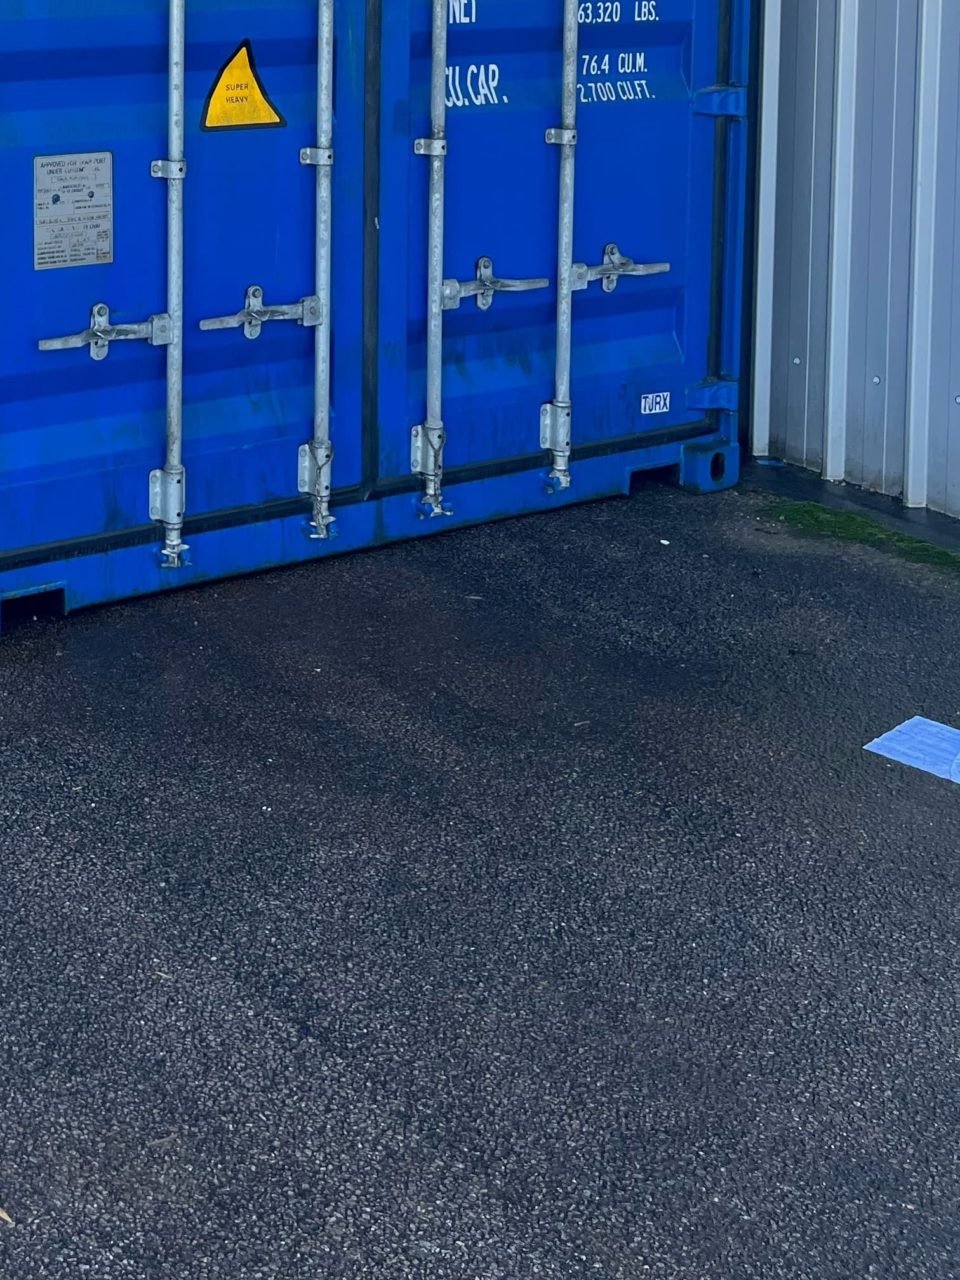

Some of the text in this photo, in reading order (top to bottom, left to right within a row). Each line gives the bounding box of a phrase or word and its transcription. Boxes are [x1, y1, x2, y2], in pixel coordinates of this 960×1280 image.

[577, 1, 659, 24] 63,320 LBS.
[581, 52, 648, 75] 76.4 CU.M.
[225, 83, 249, 91] SUPER
[616, 80, 656, 101] CU.FT.
[225, 96, 248, 104] HEAVY
